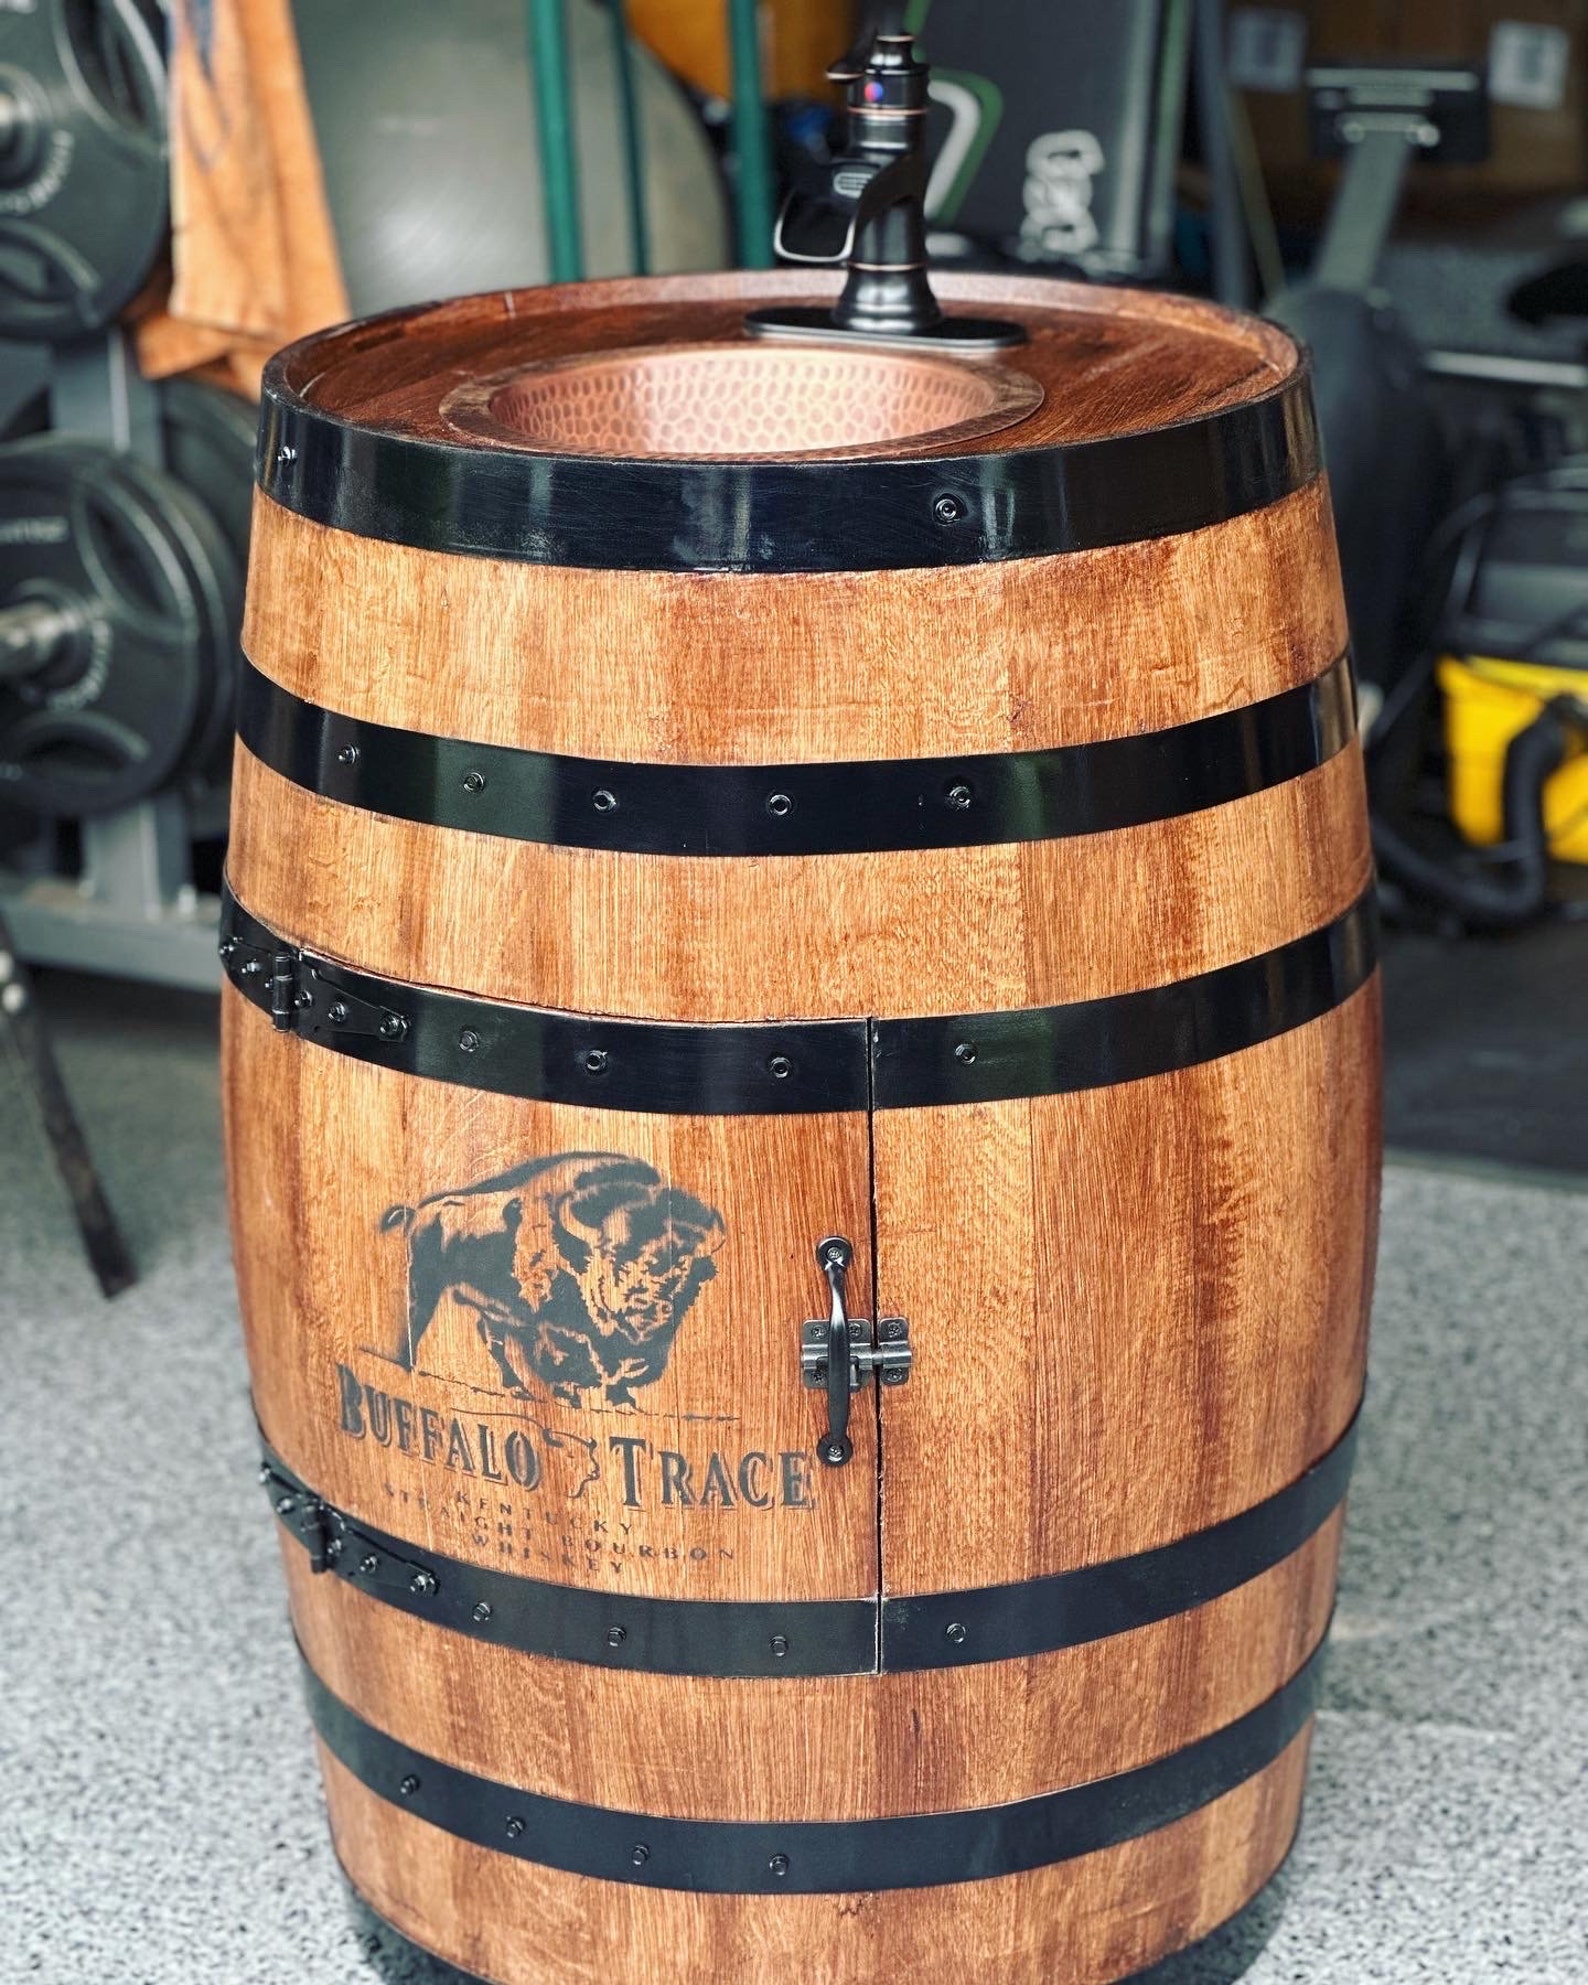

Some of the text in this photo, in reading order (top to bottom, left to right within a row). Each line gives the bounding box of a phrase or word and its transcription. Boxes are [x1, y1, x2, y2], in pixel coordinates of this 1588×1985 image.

[338, 1363, 815, 1513] BUFFALO TRACE
[561, 1534, 734, 1561] BOURBON
